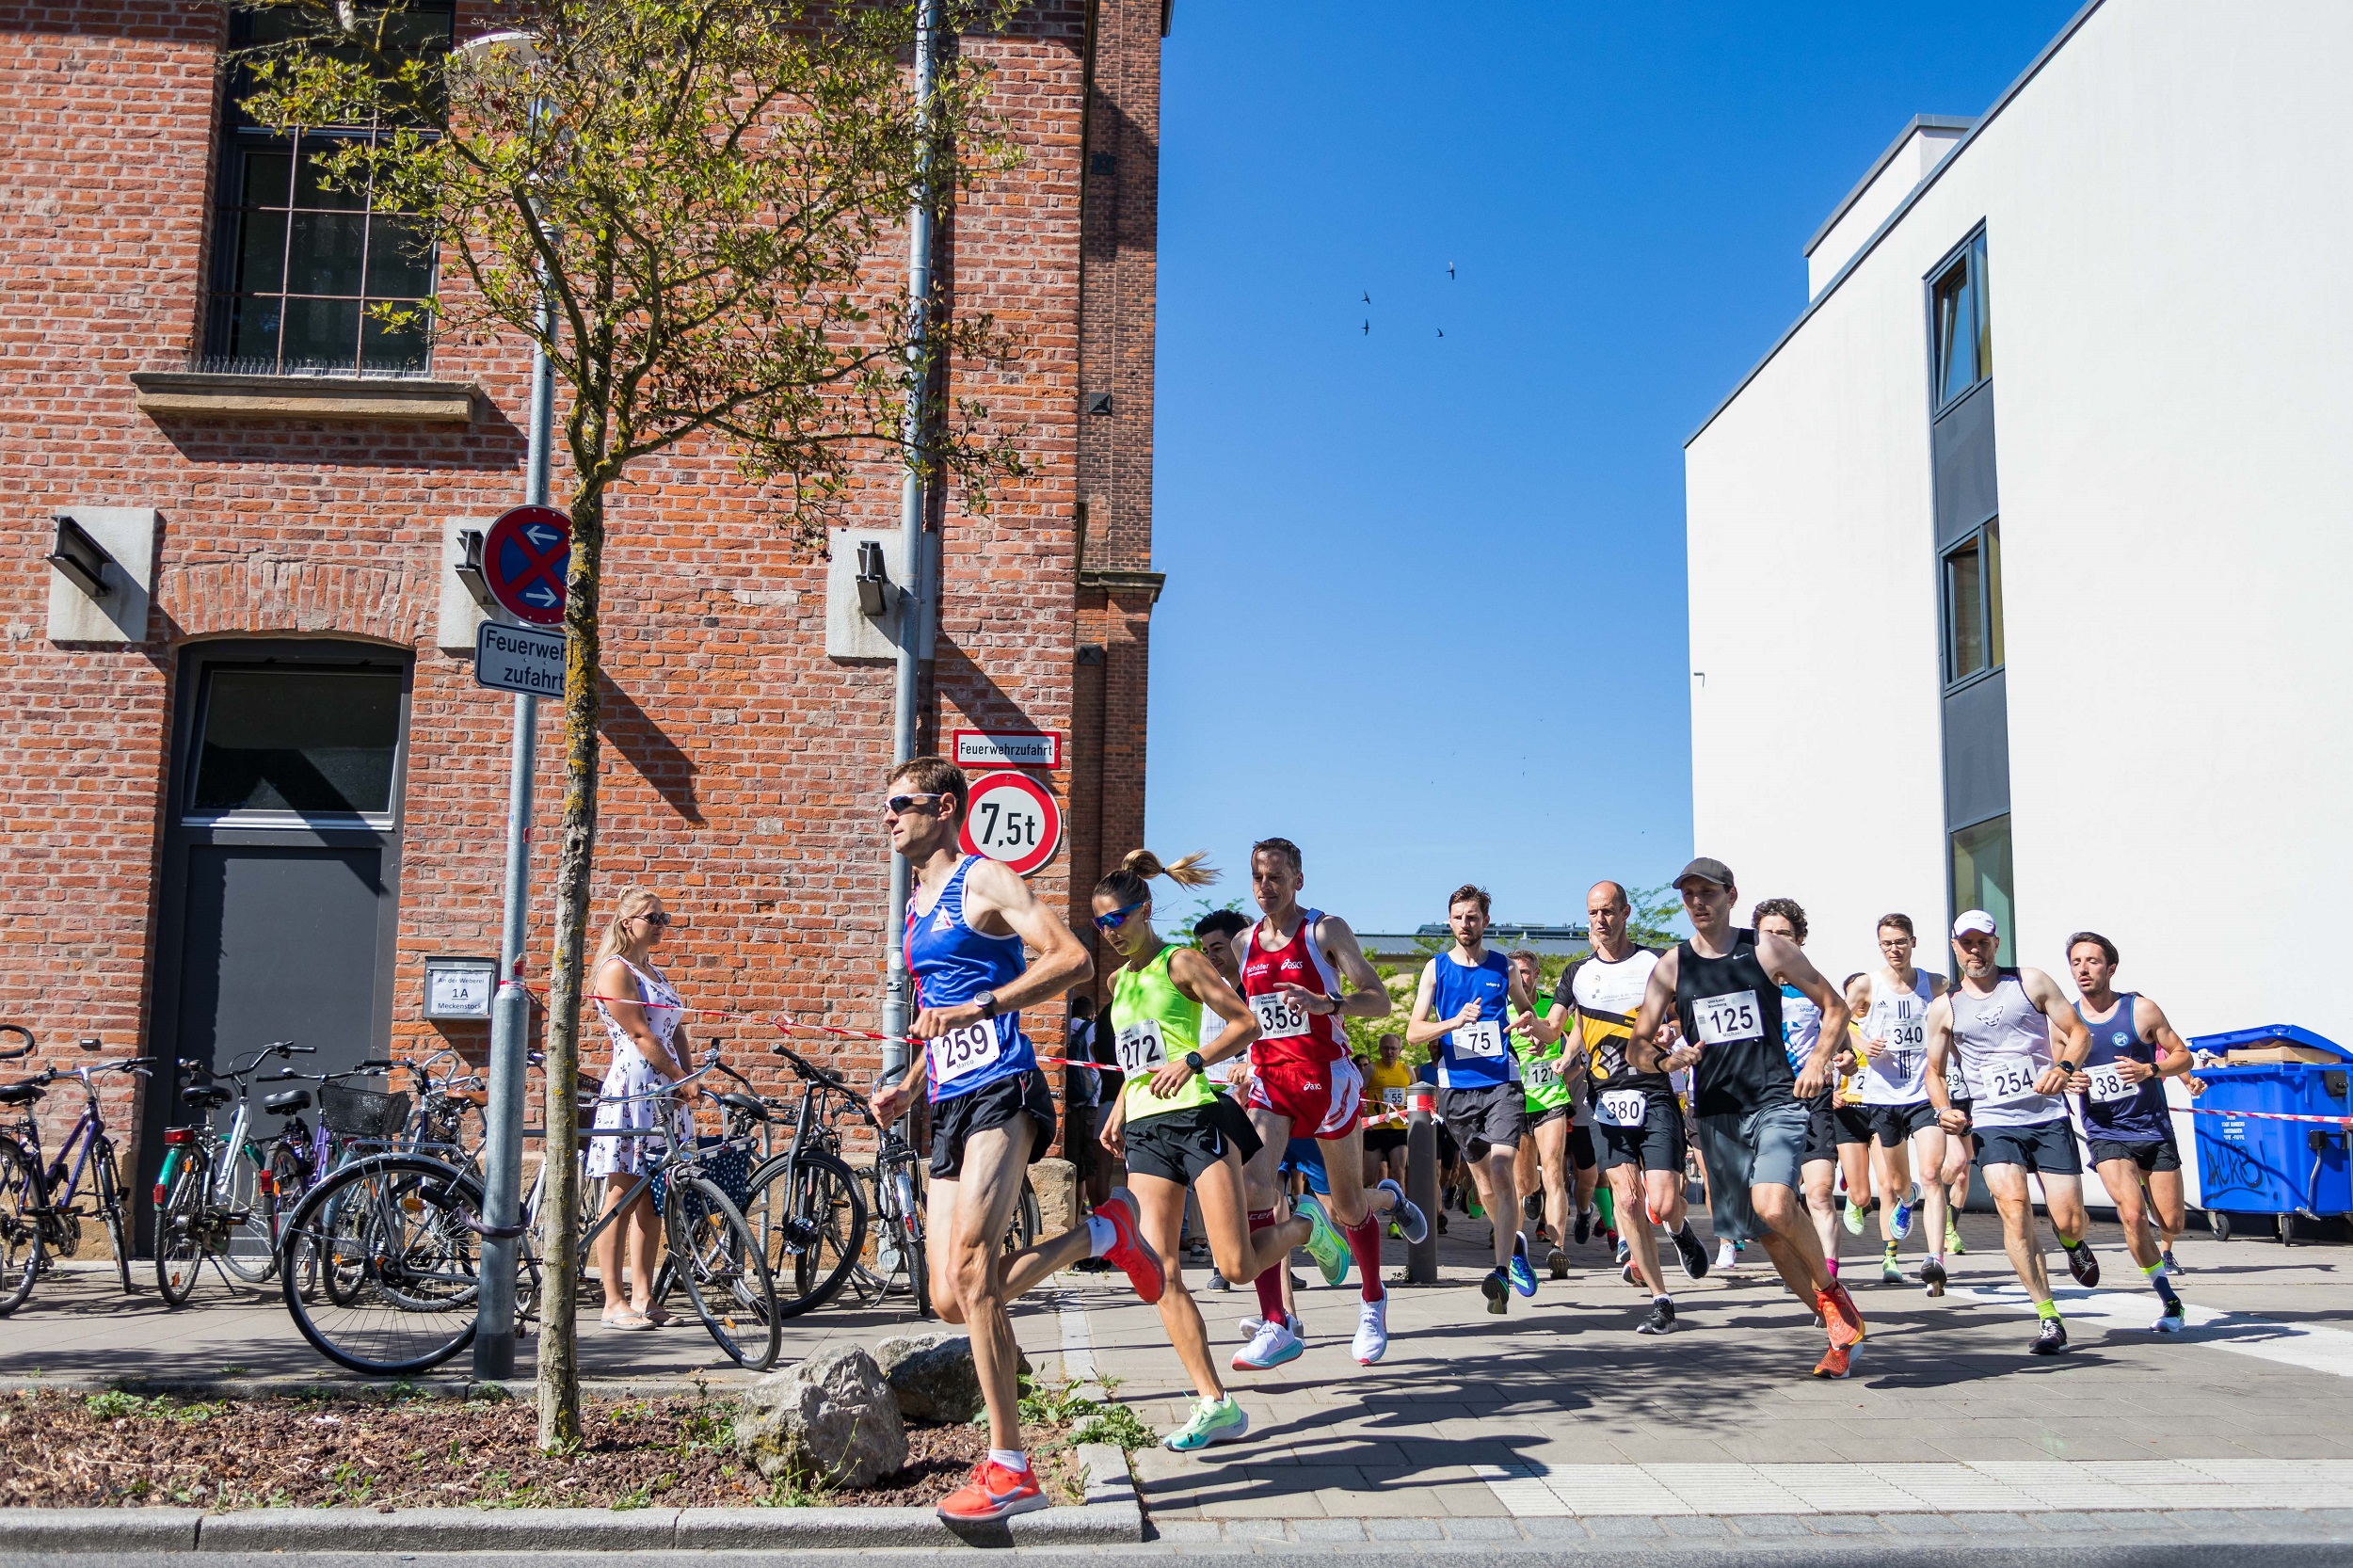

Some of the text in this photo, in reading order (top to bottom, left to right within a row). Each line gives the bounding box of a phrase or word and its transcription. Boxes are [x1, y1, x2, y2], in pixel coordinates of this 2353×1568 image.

[486, 629, 567, 661] Feuerweh
[504, 666, 565, 691] zufahrt
[960, 742, 1052, 757] Feuerwehrzufahrt
[981, 803, 1035, 847] 7,5t
[1261, 1004, 1303, 1032] 358
[1710, 1004, 1753, 1033] 125
[942, 1024, 988, 1069] 259
[1468, 1032, 1491, 1051] 75
[1894, 1026, 1923, 1045] 340
[956, 1059, 975, 1069] Marco
[1122, 1034, 1161, 1071] 272
[1532, 1066, 1554, 1083] 127
[1994, 1067, 2034, 1096] 254
[1391, 1093, 1402, 1103] 55
[1606, 1100, 1640, 1120] 380
